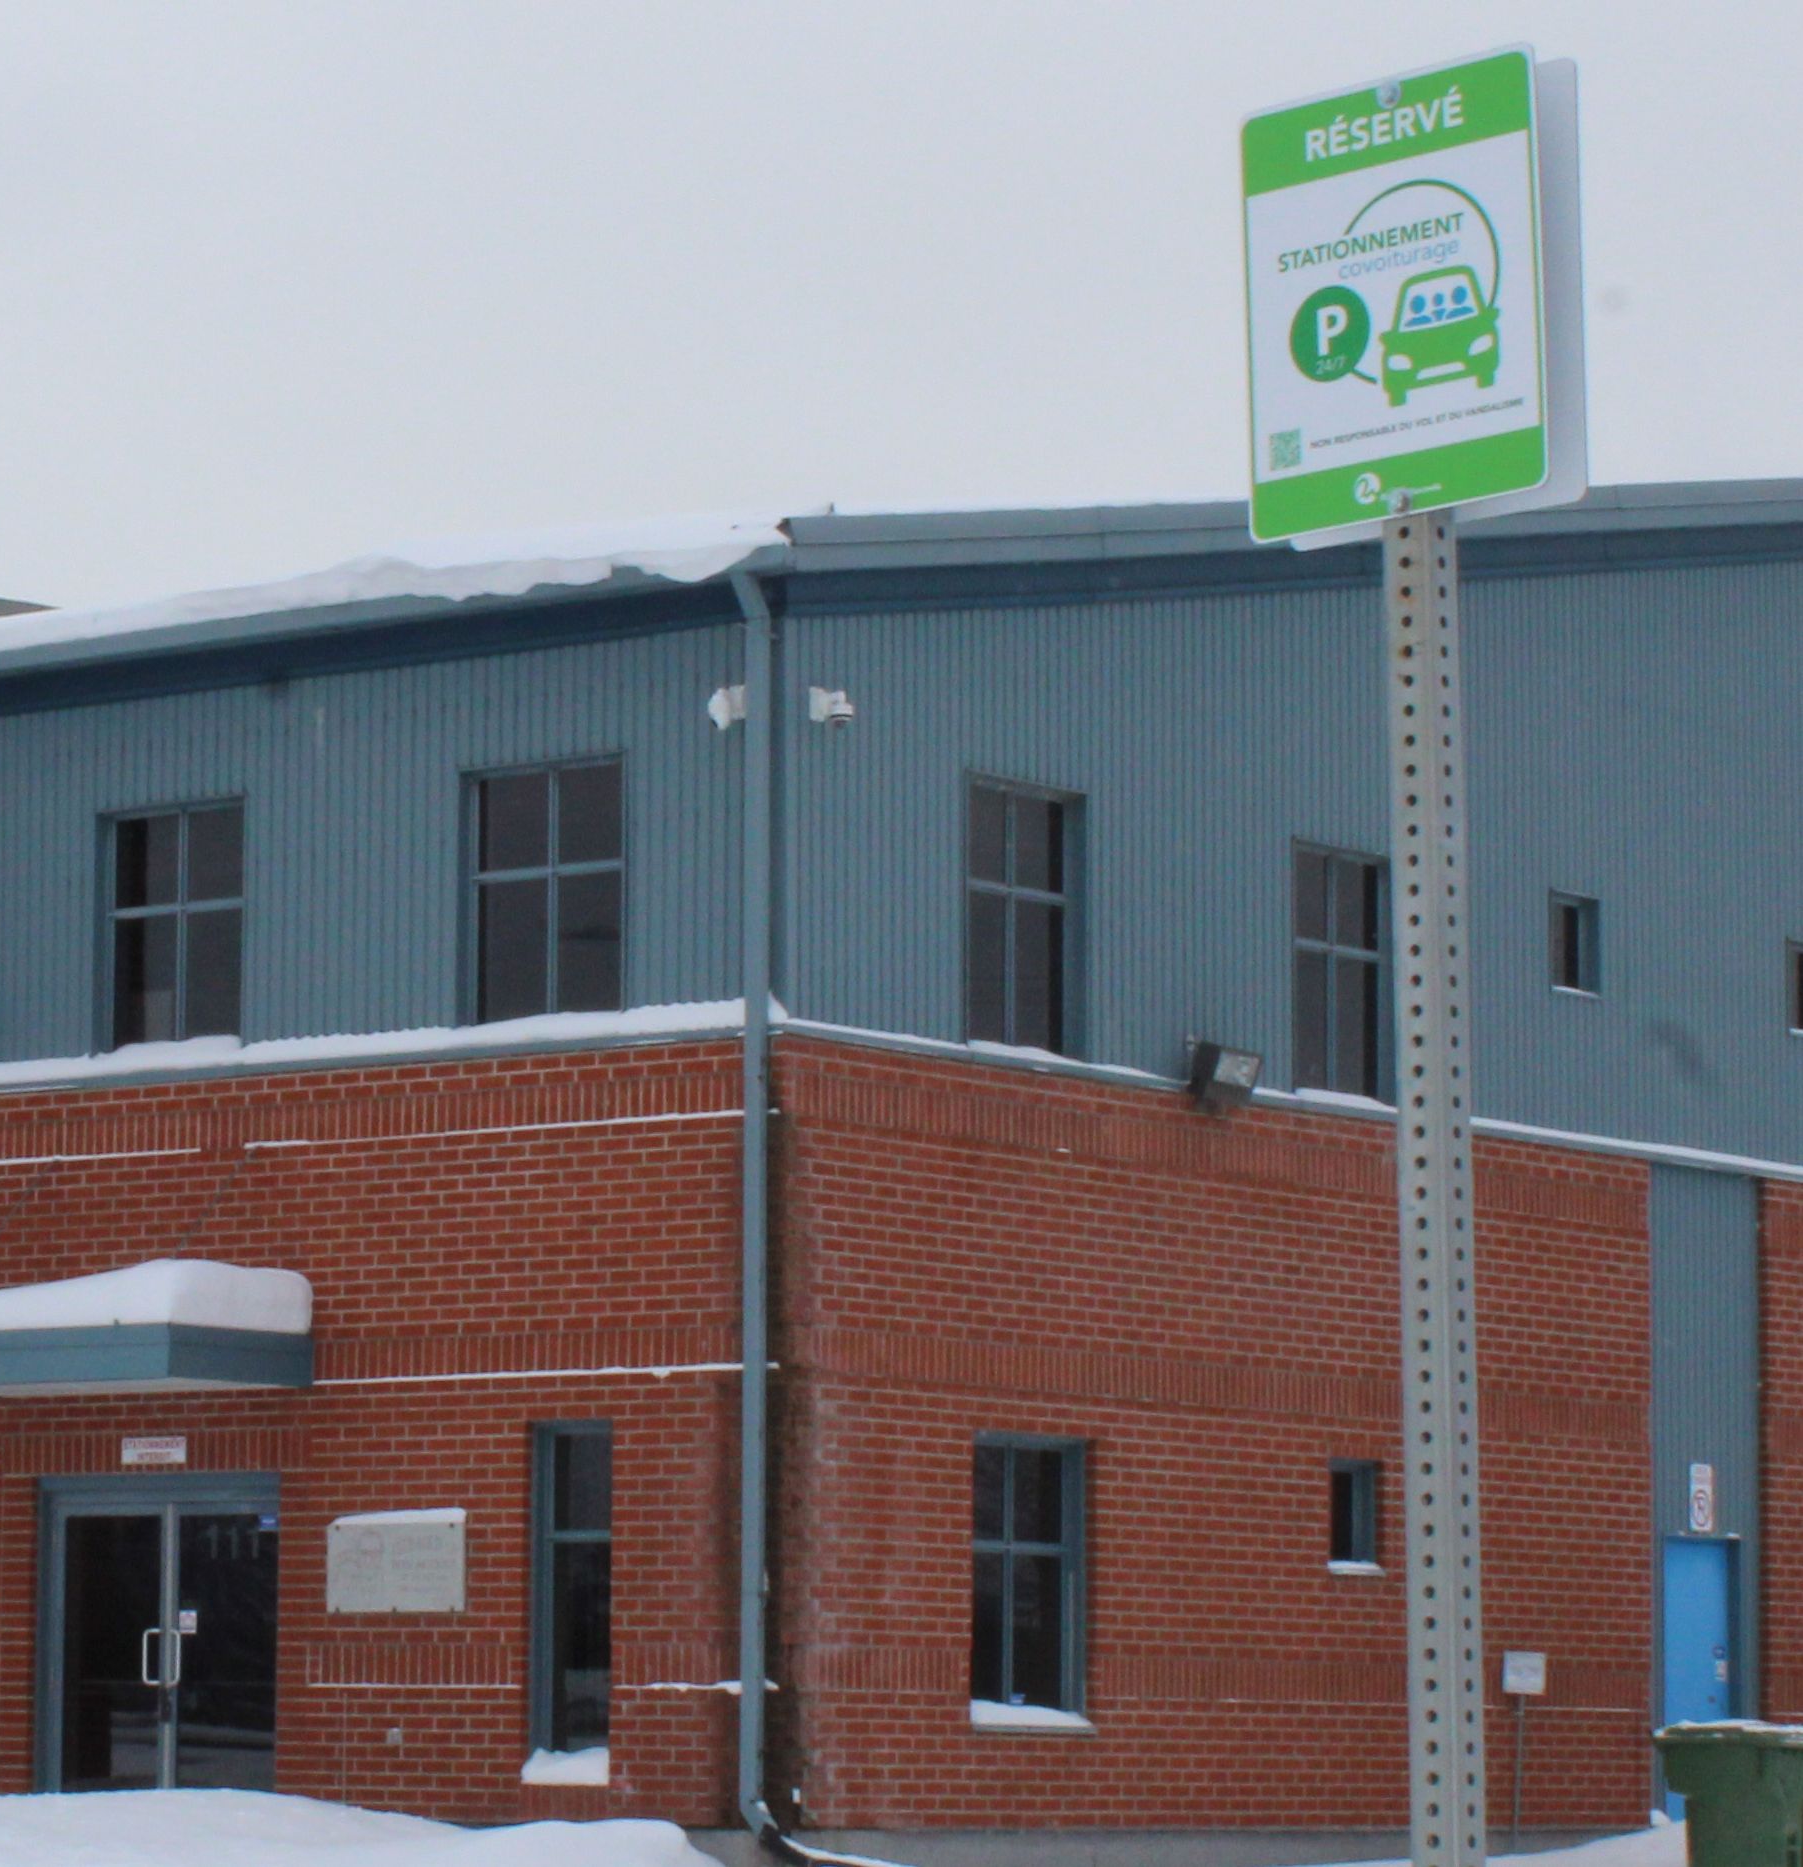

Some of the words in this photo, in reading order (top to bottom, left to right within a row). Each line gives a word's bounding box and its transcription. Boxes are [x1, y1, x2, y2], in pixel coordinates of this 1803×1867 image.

[1305, 85, 1465, 162] RÉSERVÉ
[1277, 212, 1464, 273] STATIONNEMENT
[1337, 239, 1460, 280] covoiturage
[1316, 304, 1348, 355] P
[1315, 354, 1347, 376] 24/7
[1309, 438, 1332, 449] NON
[1334, 425, 1396, 444] RESPONSABLE
[1399, 421, 1413, 431] DU
[1415, 417, 1433, 427] VOL
[1449, 411, 1463, 421] DU
